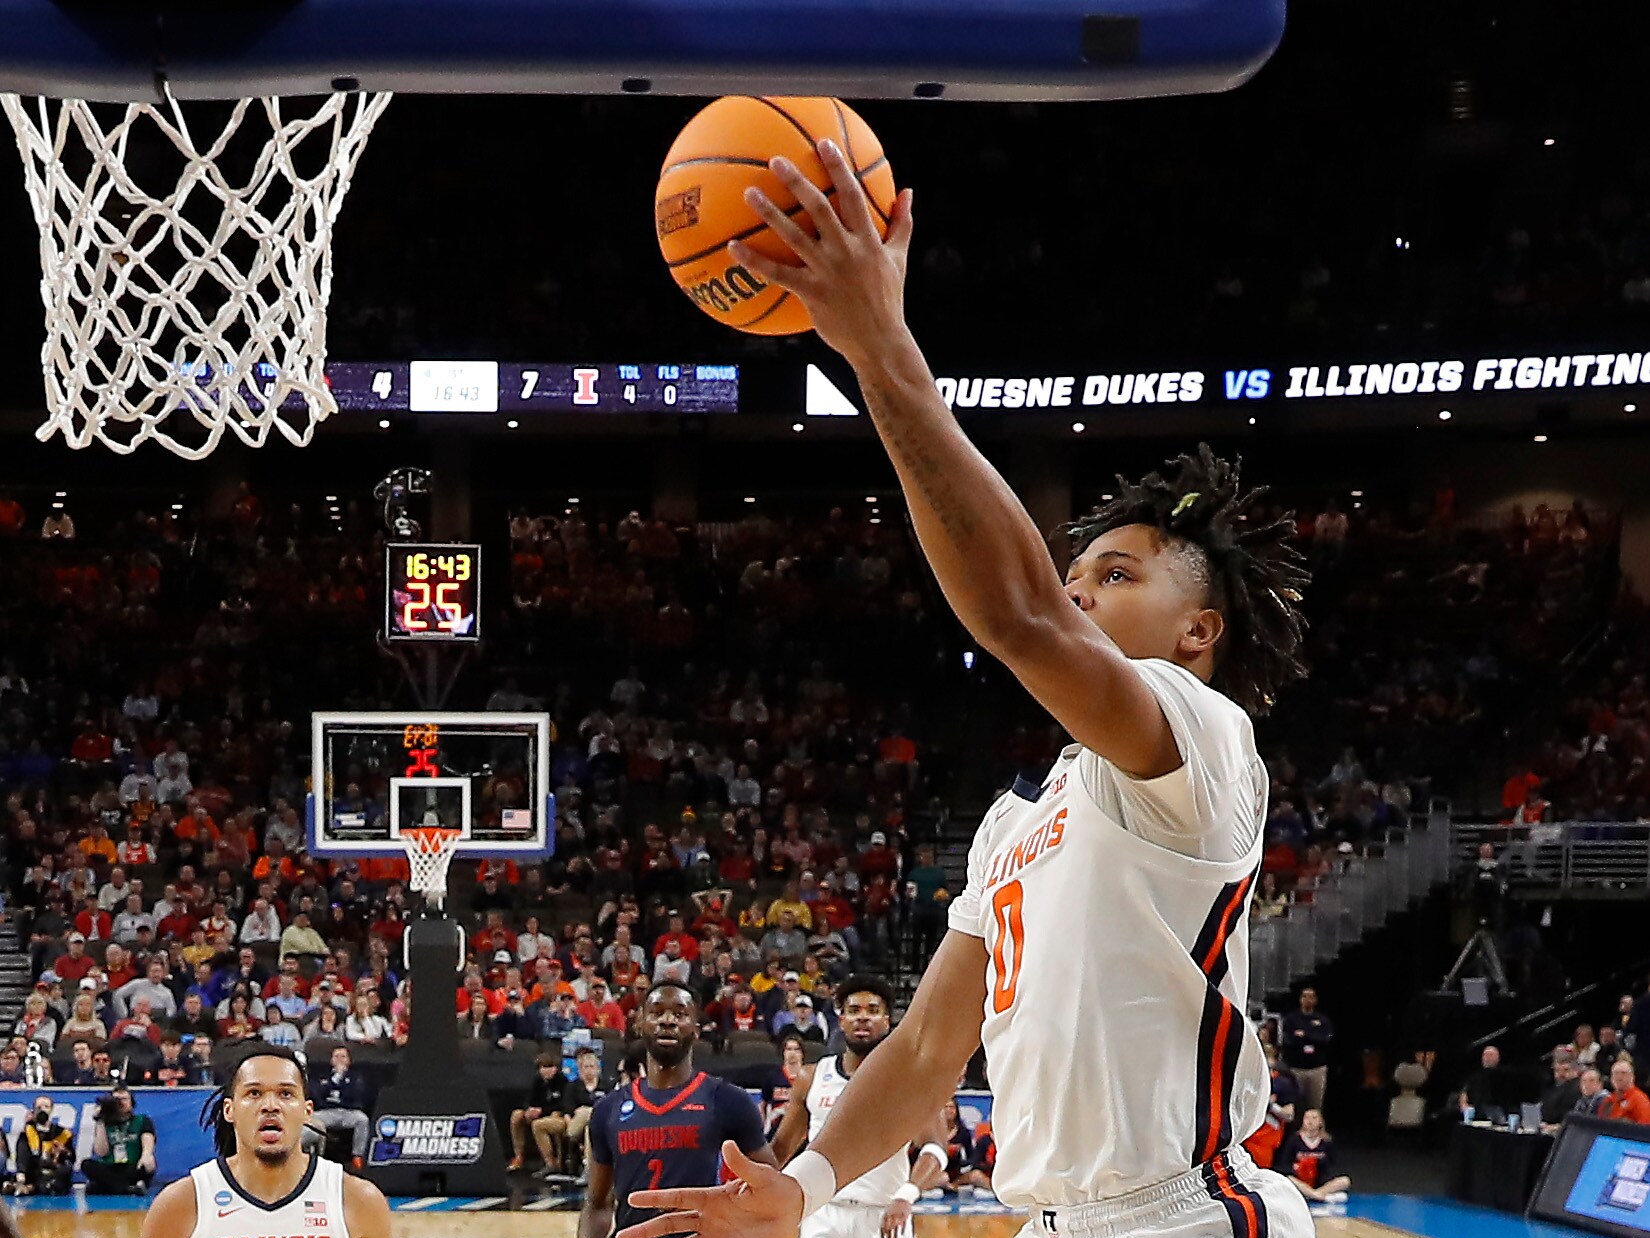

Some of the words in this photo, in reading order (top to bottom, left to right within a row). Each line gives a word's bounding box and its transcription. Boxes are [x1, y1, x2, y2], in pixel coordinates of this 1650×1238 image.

[372, 371, 392, 399] 4
[521, 370, 539, 399] 7
[618, 364, 641, 380] TOL
[657, 364, 680, 380] FLS
[1082, 372, 1204, 405] DUKES
[1225, 369, 1270, 399] VS
[1285, 361, 1463, 398] ILLINOIS
[623, 384, 636, 405] 4
[663, 384, 677, 405] 0
[406, 553, 471, 581] 16:43
[404, 582, 462, 629] 25
[992, 879, 1025, 1015] 0
[395, 1119, 454, 1138] MARCH
[617, 1125, 701, 1156] DUQUESNE
[401, 1137, 481, 1156] MADNESS
